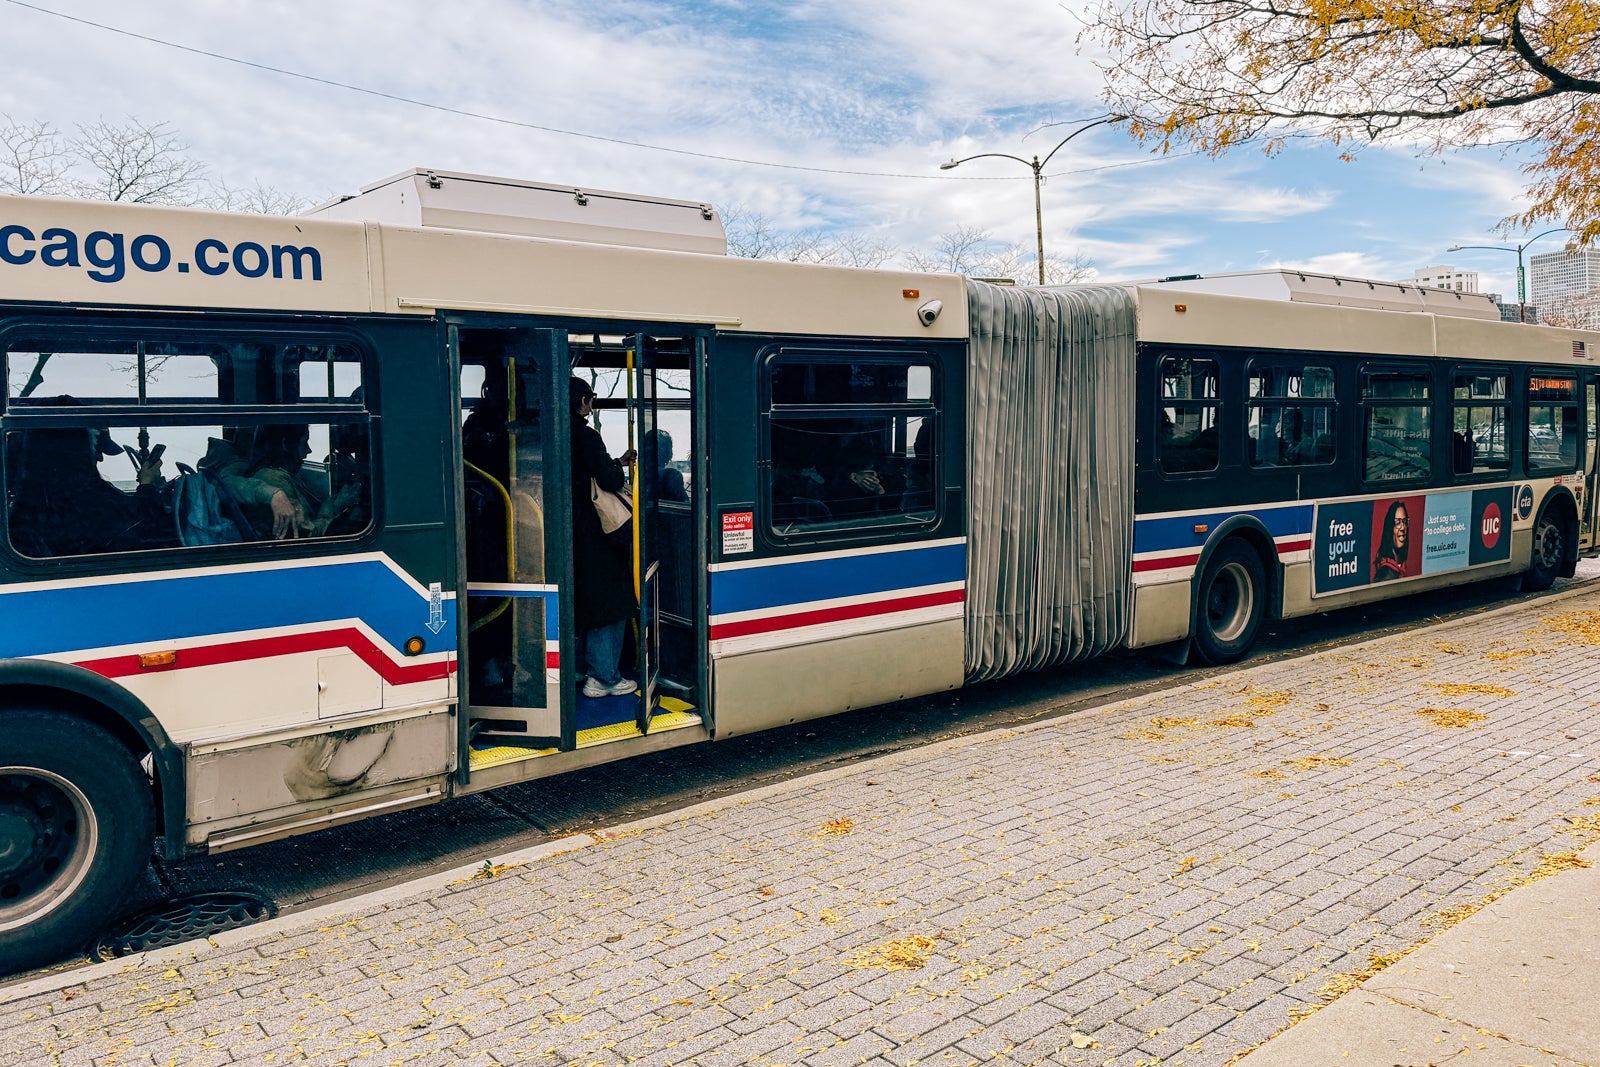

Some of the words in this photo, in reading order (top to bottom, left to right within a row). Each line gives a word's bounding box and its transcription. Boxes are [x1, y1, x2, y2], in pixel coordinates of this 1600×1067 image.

[0, 224, 322, 283] cago.com
[1520, 496, 1532, 508] cta
[723, 515, 737, 523] Exit
[737, 514, 752, 523] only
[1428, 515, 1439, 524] Just
[1440, 515, 1449, 524] say
[1482, 517, 1500, 535] UIC
[1329, 519, 1353, 537] free
[1433, 525, 1451, 535] college
[1329, 540, 1356, 560] your
[1426, 541, 1457, 553] free.uic.edu
[1328, 555, 1358, 577] mind
